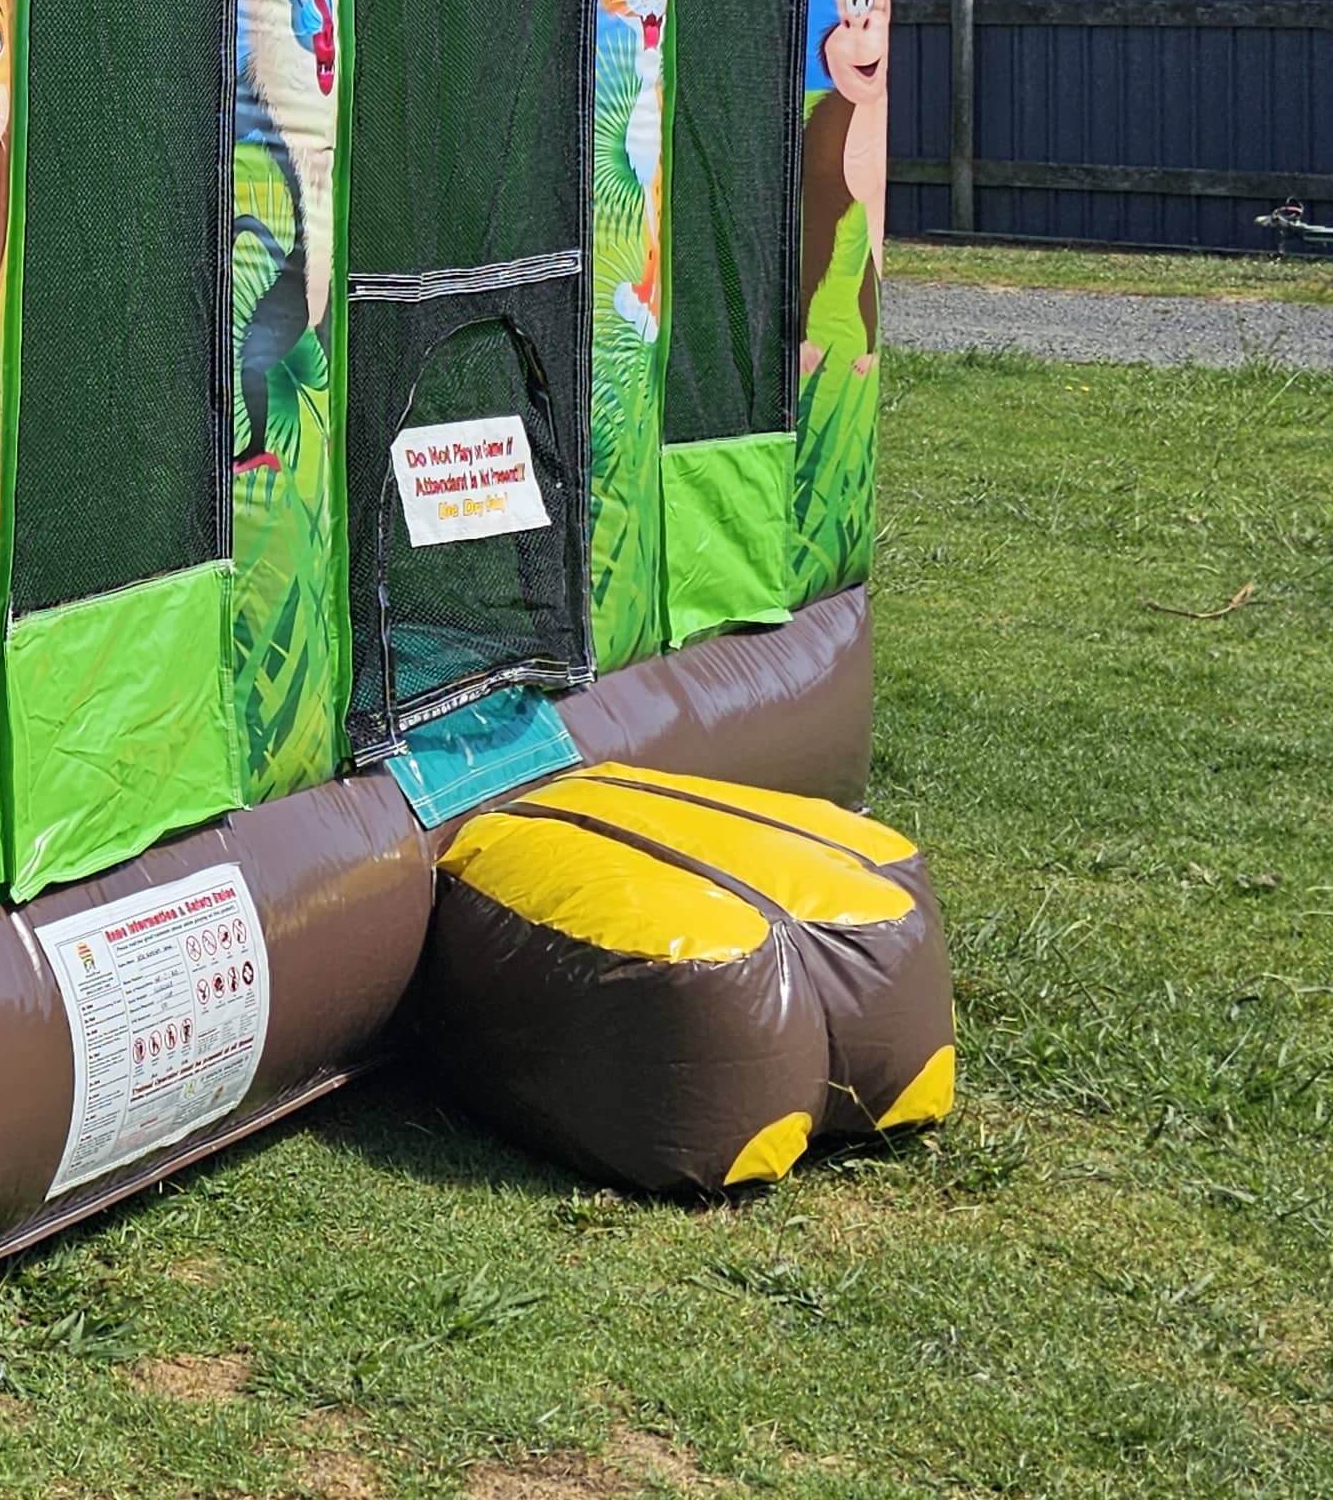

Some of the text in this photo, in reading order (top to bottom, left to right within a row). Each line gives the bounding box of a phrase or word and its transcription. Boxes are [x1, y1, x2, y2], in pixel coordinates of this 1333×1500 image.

[405, 449, 426, 468] Do
[428, 445, 452, 466] Not
[453, 443, 473, 466] Play
[416, 473, 468, 497] Attendant
[126, 908, 179, 934] Information
[185, 895, 213, 914] Safety
